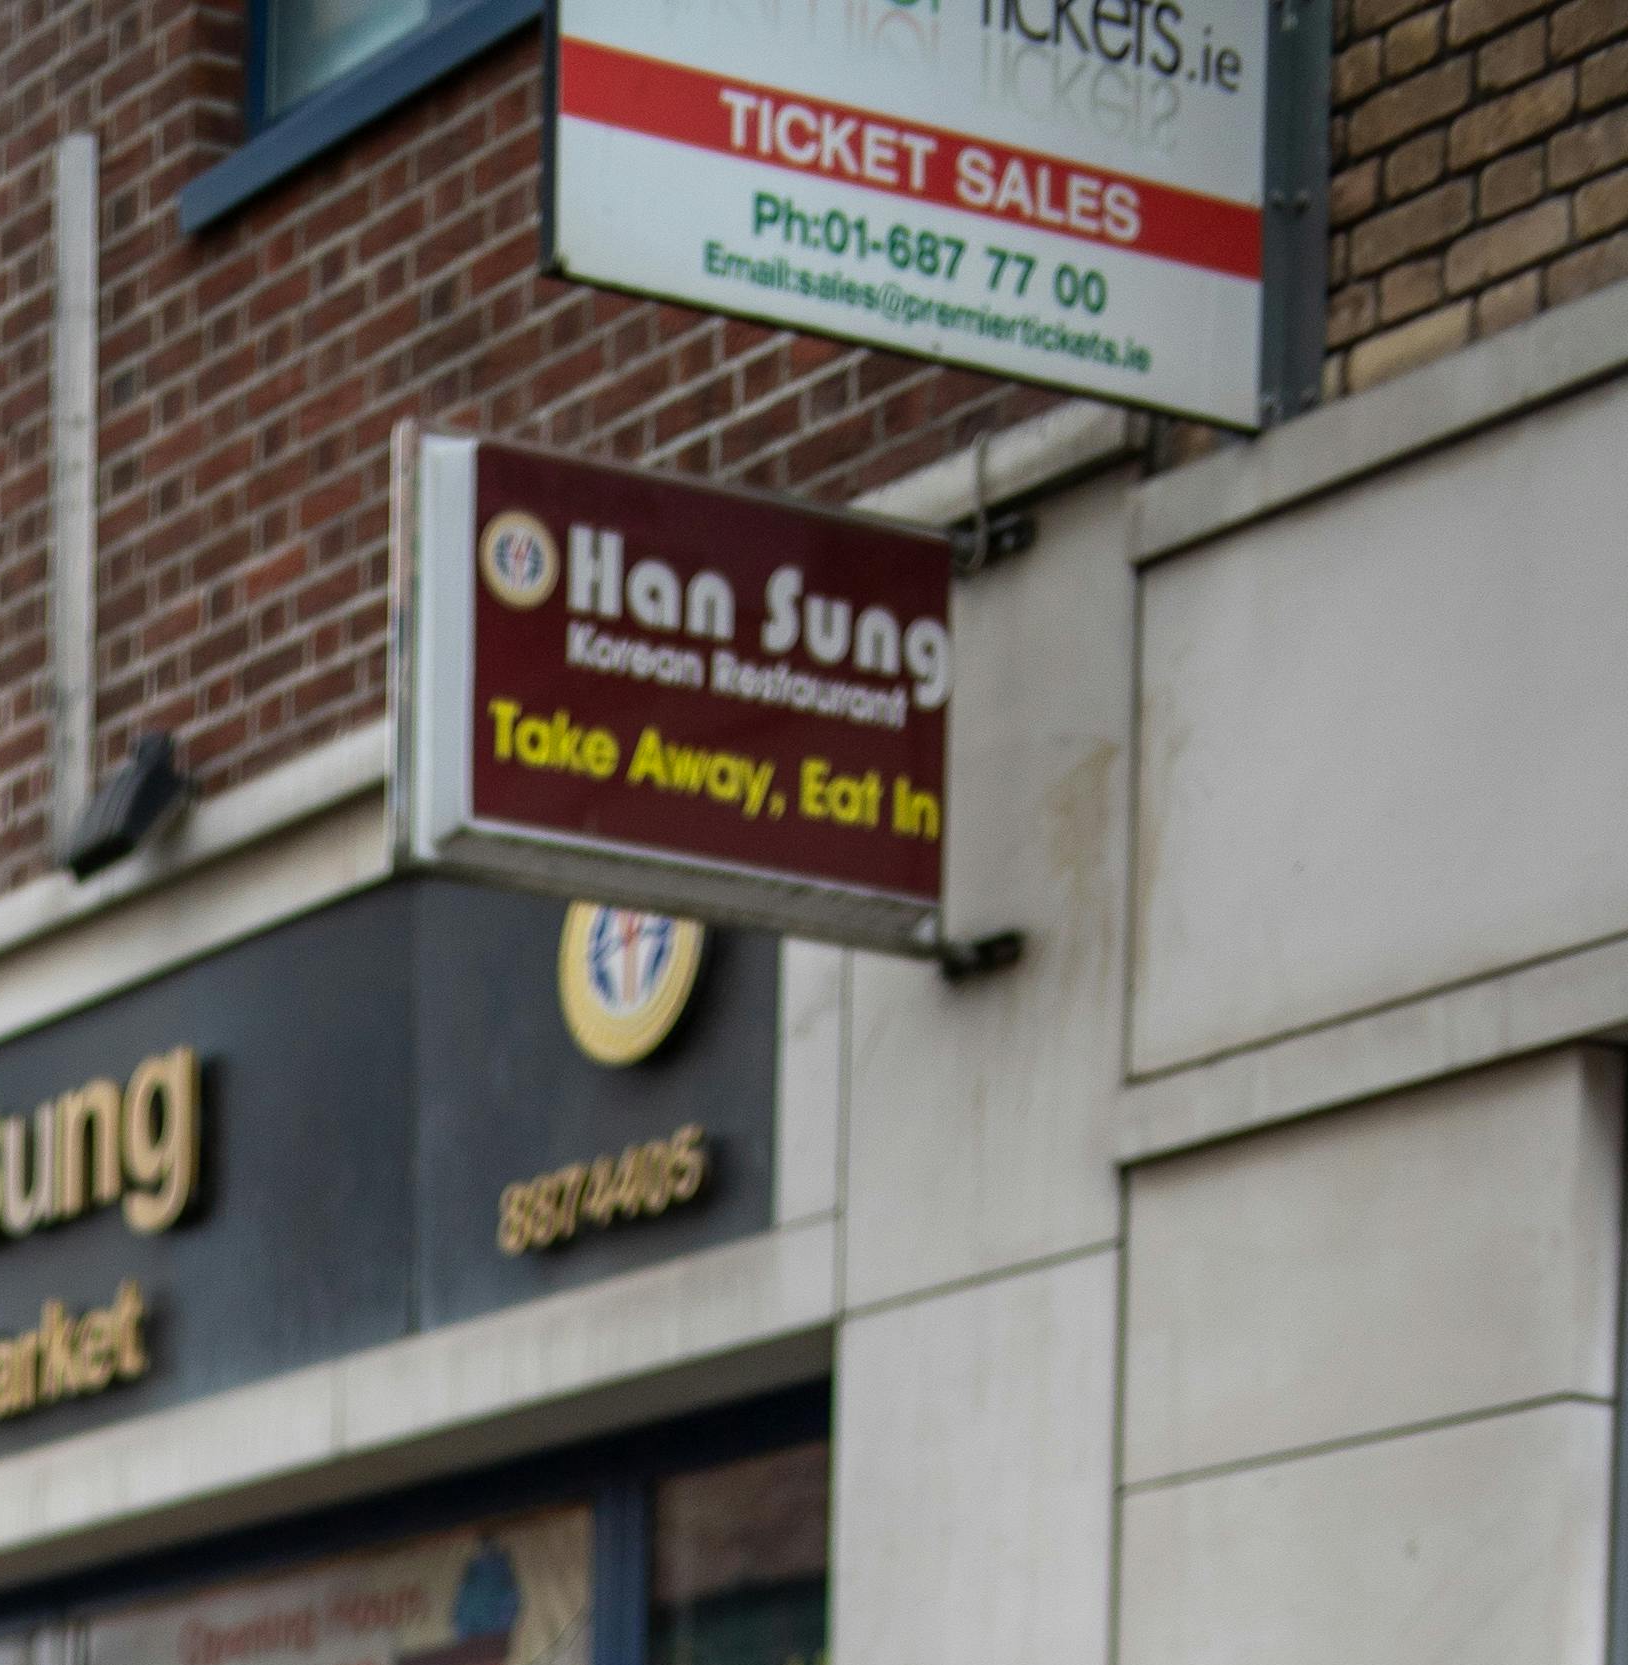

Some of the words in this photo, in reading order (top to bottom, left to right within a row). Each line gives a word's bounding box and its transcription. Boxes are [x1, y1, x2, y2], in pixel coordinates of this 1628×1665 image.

[980, 0, 1244, 92] ckets.ie
[720, 90, 938, 191] TICKET
[955, 147, 1142, 243] SALES
[704, 240, 1152, 373] Email:sales@premiertickets.ie
[753, 191, 967, 281] Ph:01-687
[985, 244, 1036, 297] 77
[1054, 263, 1108, 315] 00
[567, 523, 735, 641] Han
[761, 564, 954, 711] Sung
[567, 621, 705, 690] Korean
[710, 649, 910, 730] Restaurant
[488, 699, 620, 780] Take
[627, 727, 787, 819] Away,
[800, 758, 883, 827] Eat
[892, 775, 942, 843] In
